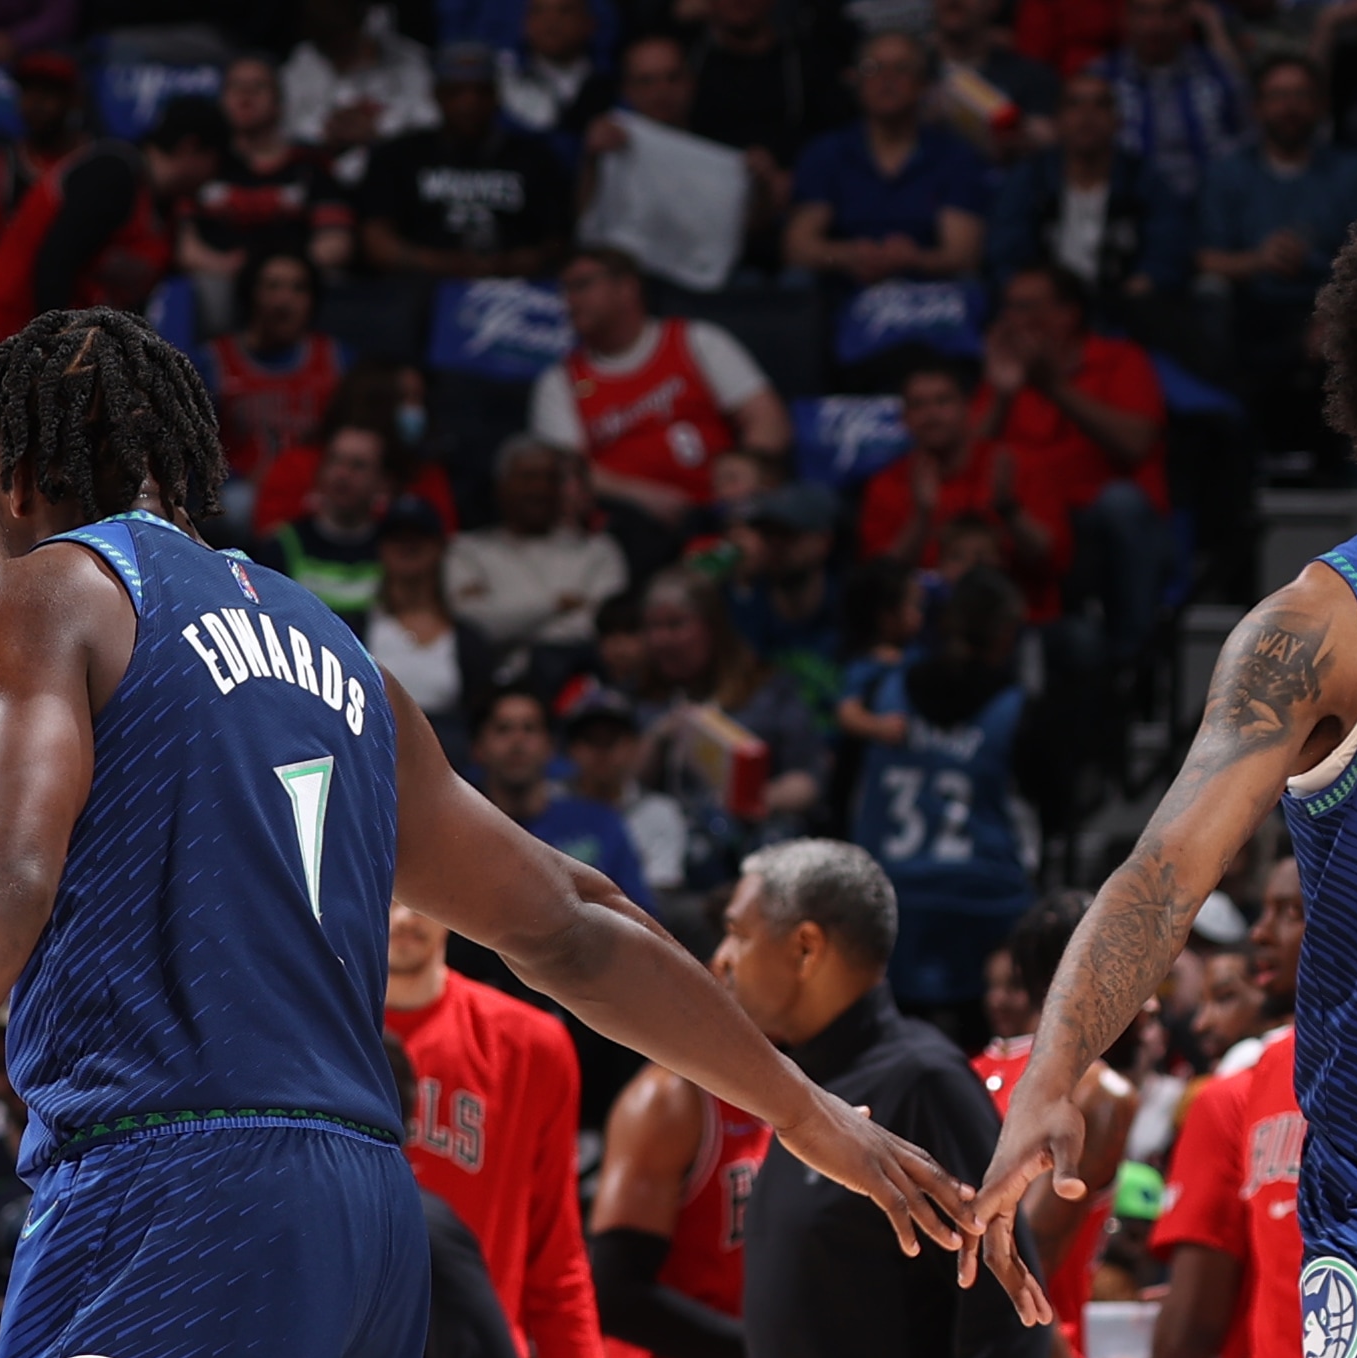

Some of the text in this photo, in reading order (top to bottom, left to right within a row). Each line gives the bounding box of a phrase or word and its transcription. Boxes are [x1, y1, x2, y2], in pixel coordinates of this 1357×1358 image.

[182, 607, 367, 736] EDWARDS
[1254, 630, 1305, 665] WAY
[273, 755, 339, 928] 1
[879, 766, 975, 864] 32
